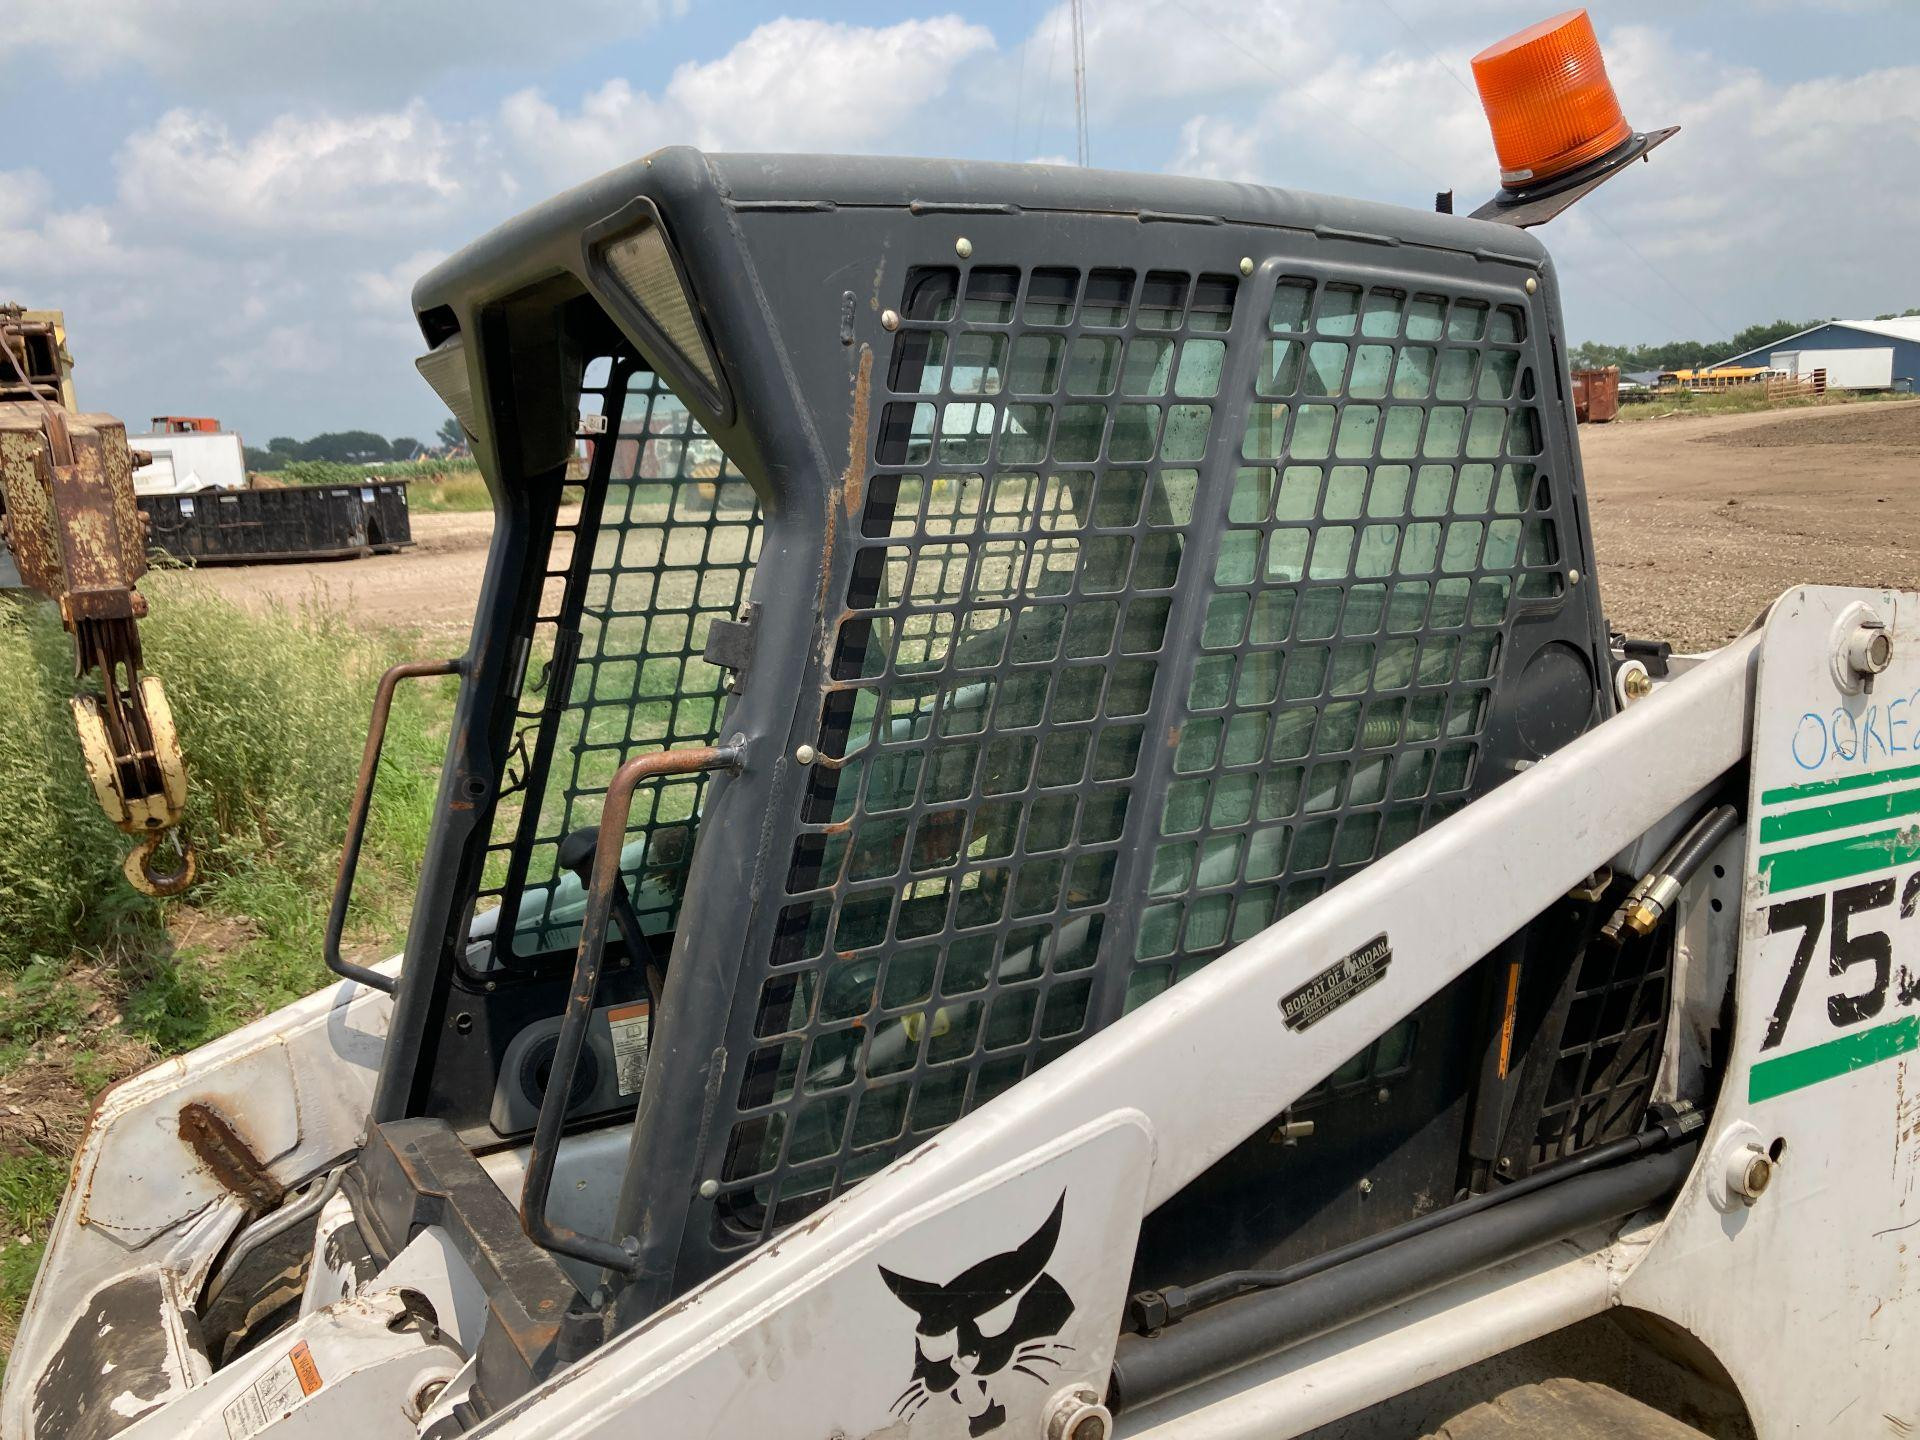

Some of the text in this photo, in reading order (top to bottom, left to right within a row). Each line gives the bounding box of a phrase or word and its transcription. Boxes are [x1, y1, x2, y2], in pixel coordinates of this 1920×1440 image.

[1285, 980, 1327, 1016] BOBCAT
[1327, 971, 1343, 988] OF
[1302, 1000, 1323, 1018] JOHN
[299, 1357, 318, 1391] WARNING
